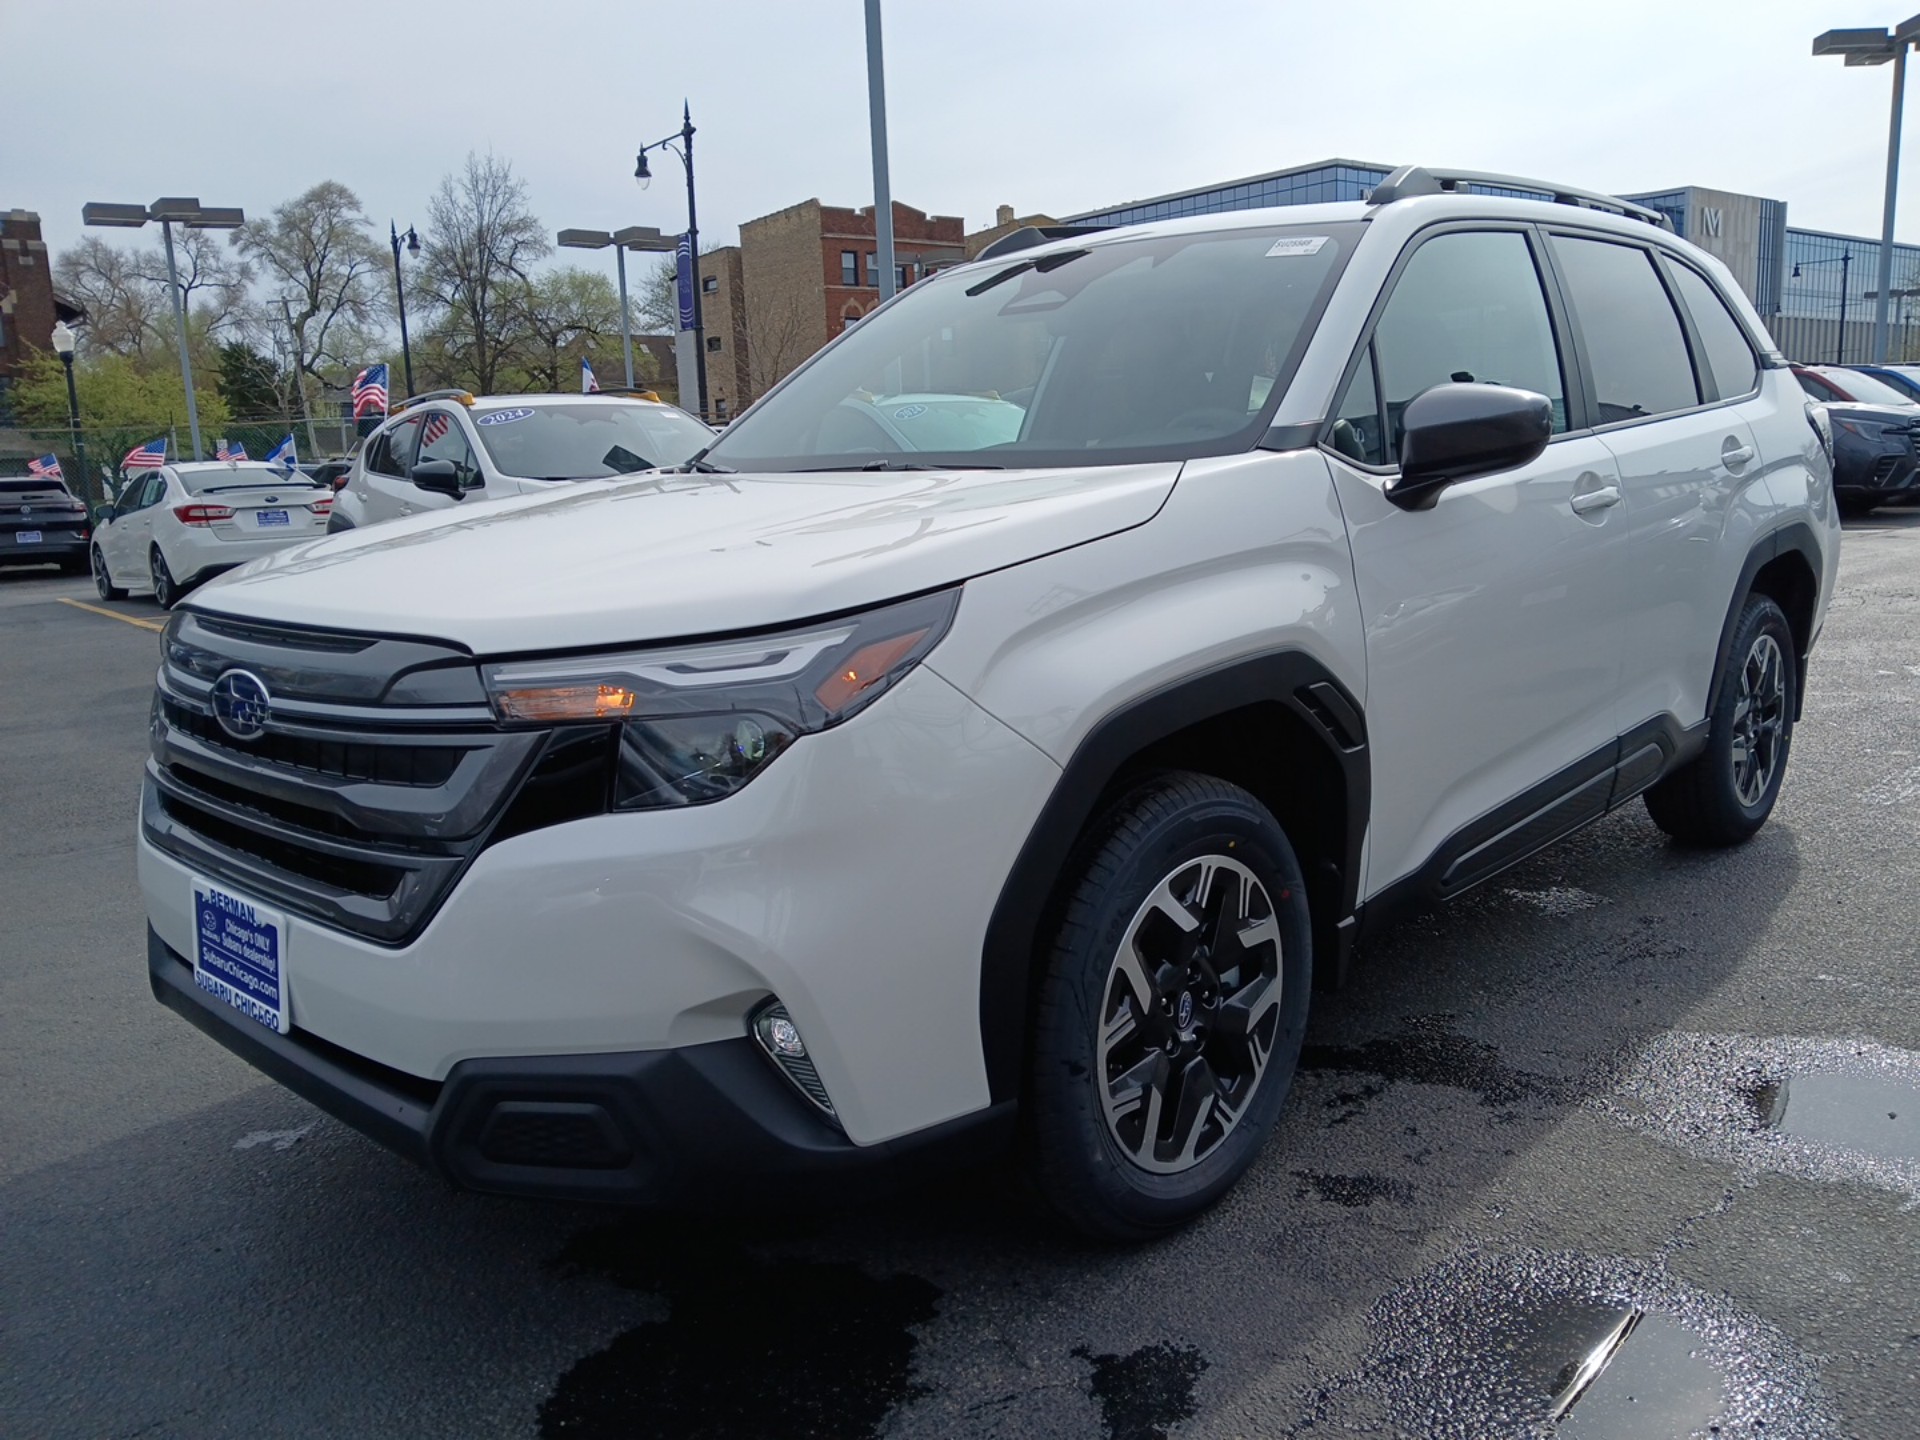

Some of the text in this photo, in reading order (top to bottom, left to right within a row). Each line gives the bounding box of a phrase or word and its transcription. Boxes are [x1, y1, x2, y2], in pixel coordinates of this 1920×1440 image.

[487, 409, 524, 424] 2024
[208, 887, 257, 924] BERMAN
[222, 931, 277, 974] Subaru dealership!
[225, 918, 270, 953] Chicago's ONLY
[202, 946, 278, 1001] SubaruChicago.com
[195, 970, 280, 1031] SUBARU CHICAGO
